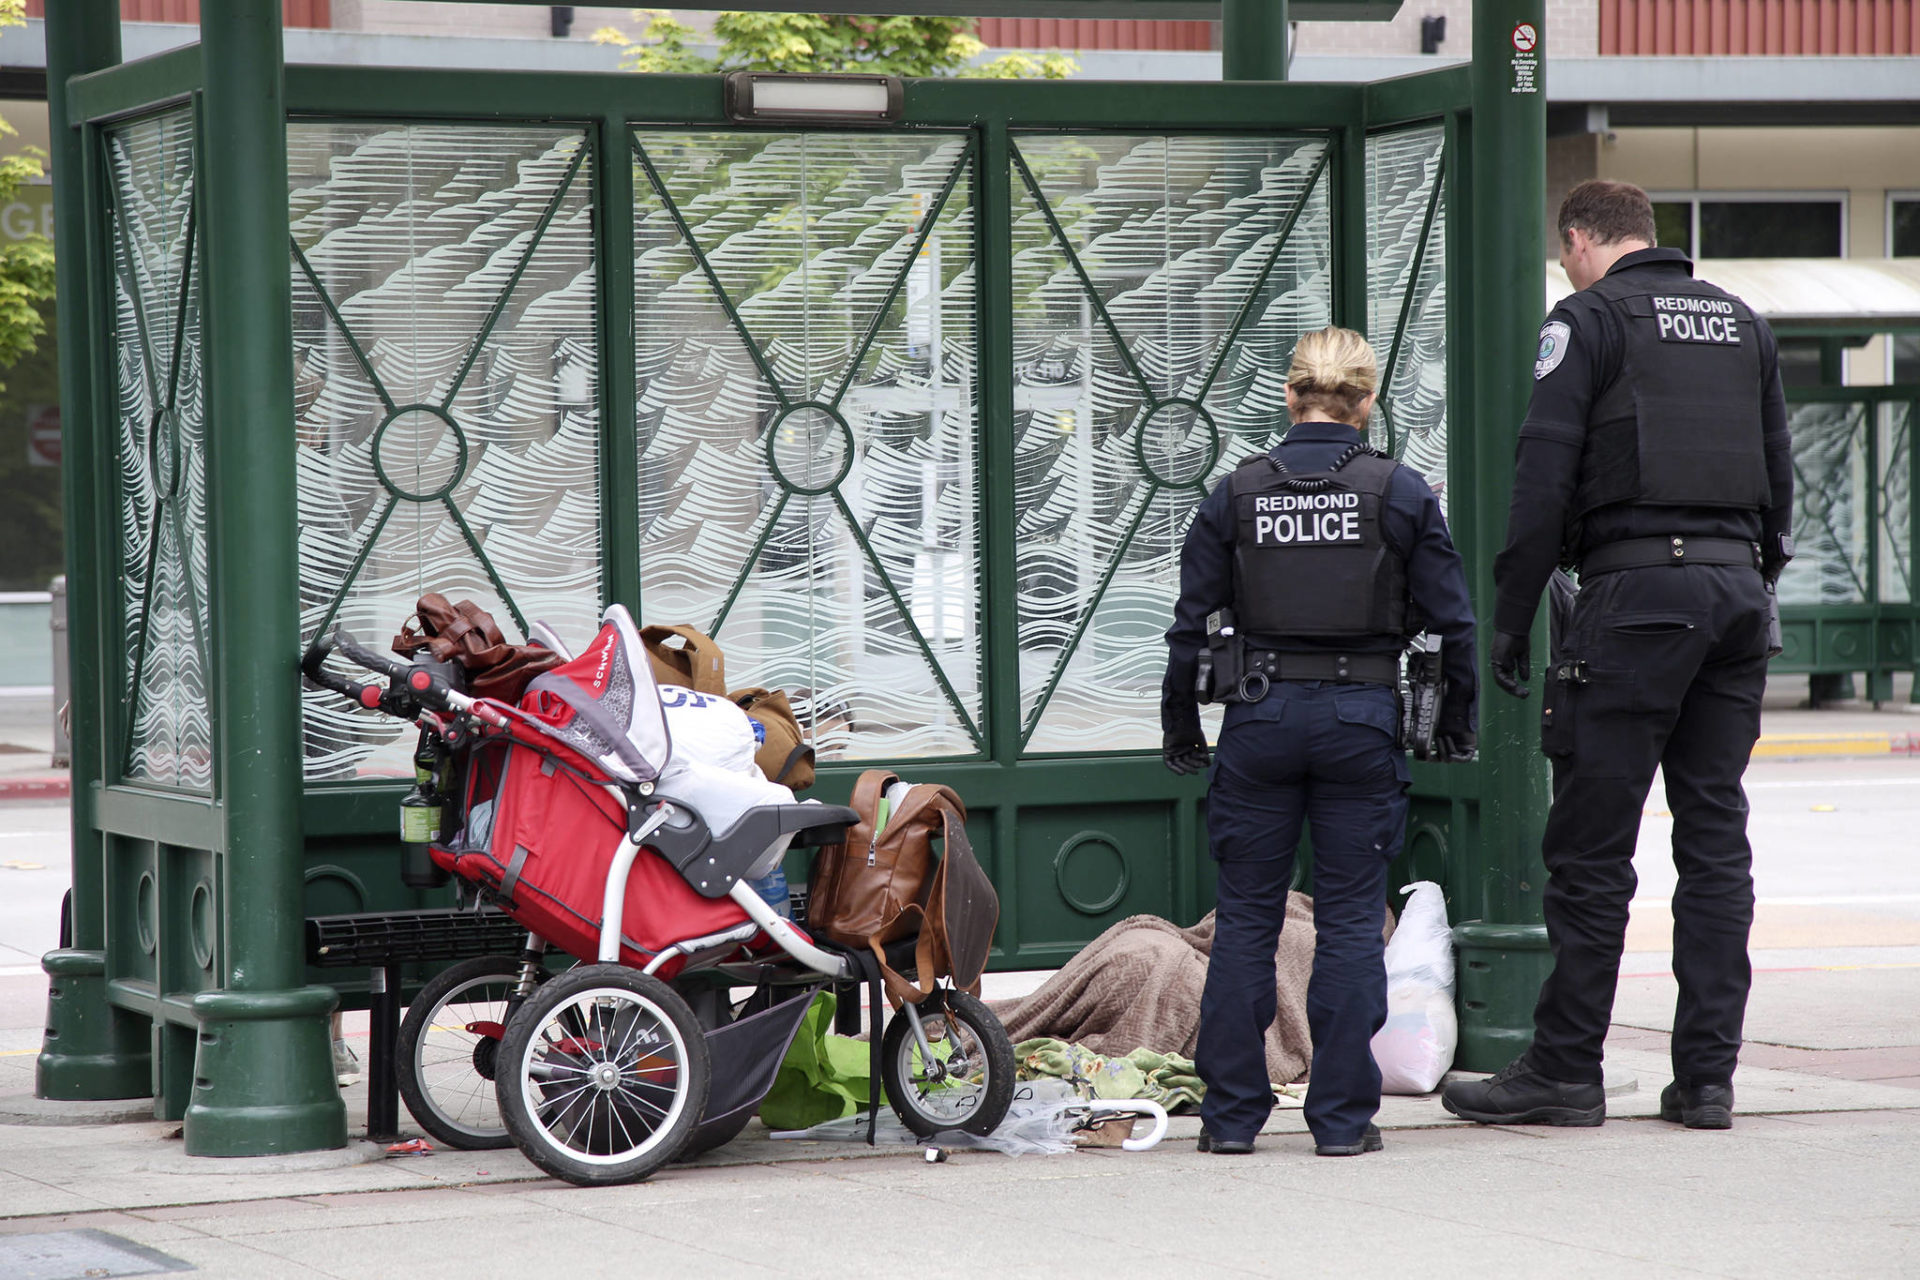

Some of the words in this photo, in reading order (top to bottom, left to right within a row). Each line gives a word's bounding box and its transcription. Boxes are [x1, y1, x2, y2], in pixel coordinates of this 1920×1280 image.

[1653, 297, 1733, 314] REDMOND
[1657, 313, 1741, 342] POLICE
[1256, 494, 1359, 512] REDMOND
[1256, 512, 1360, 544] POLICE
